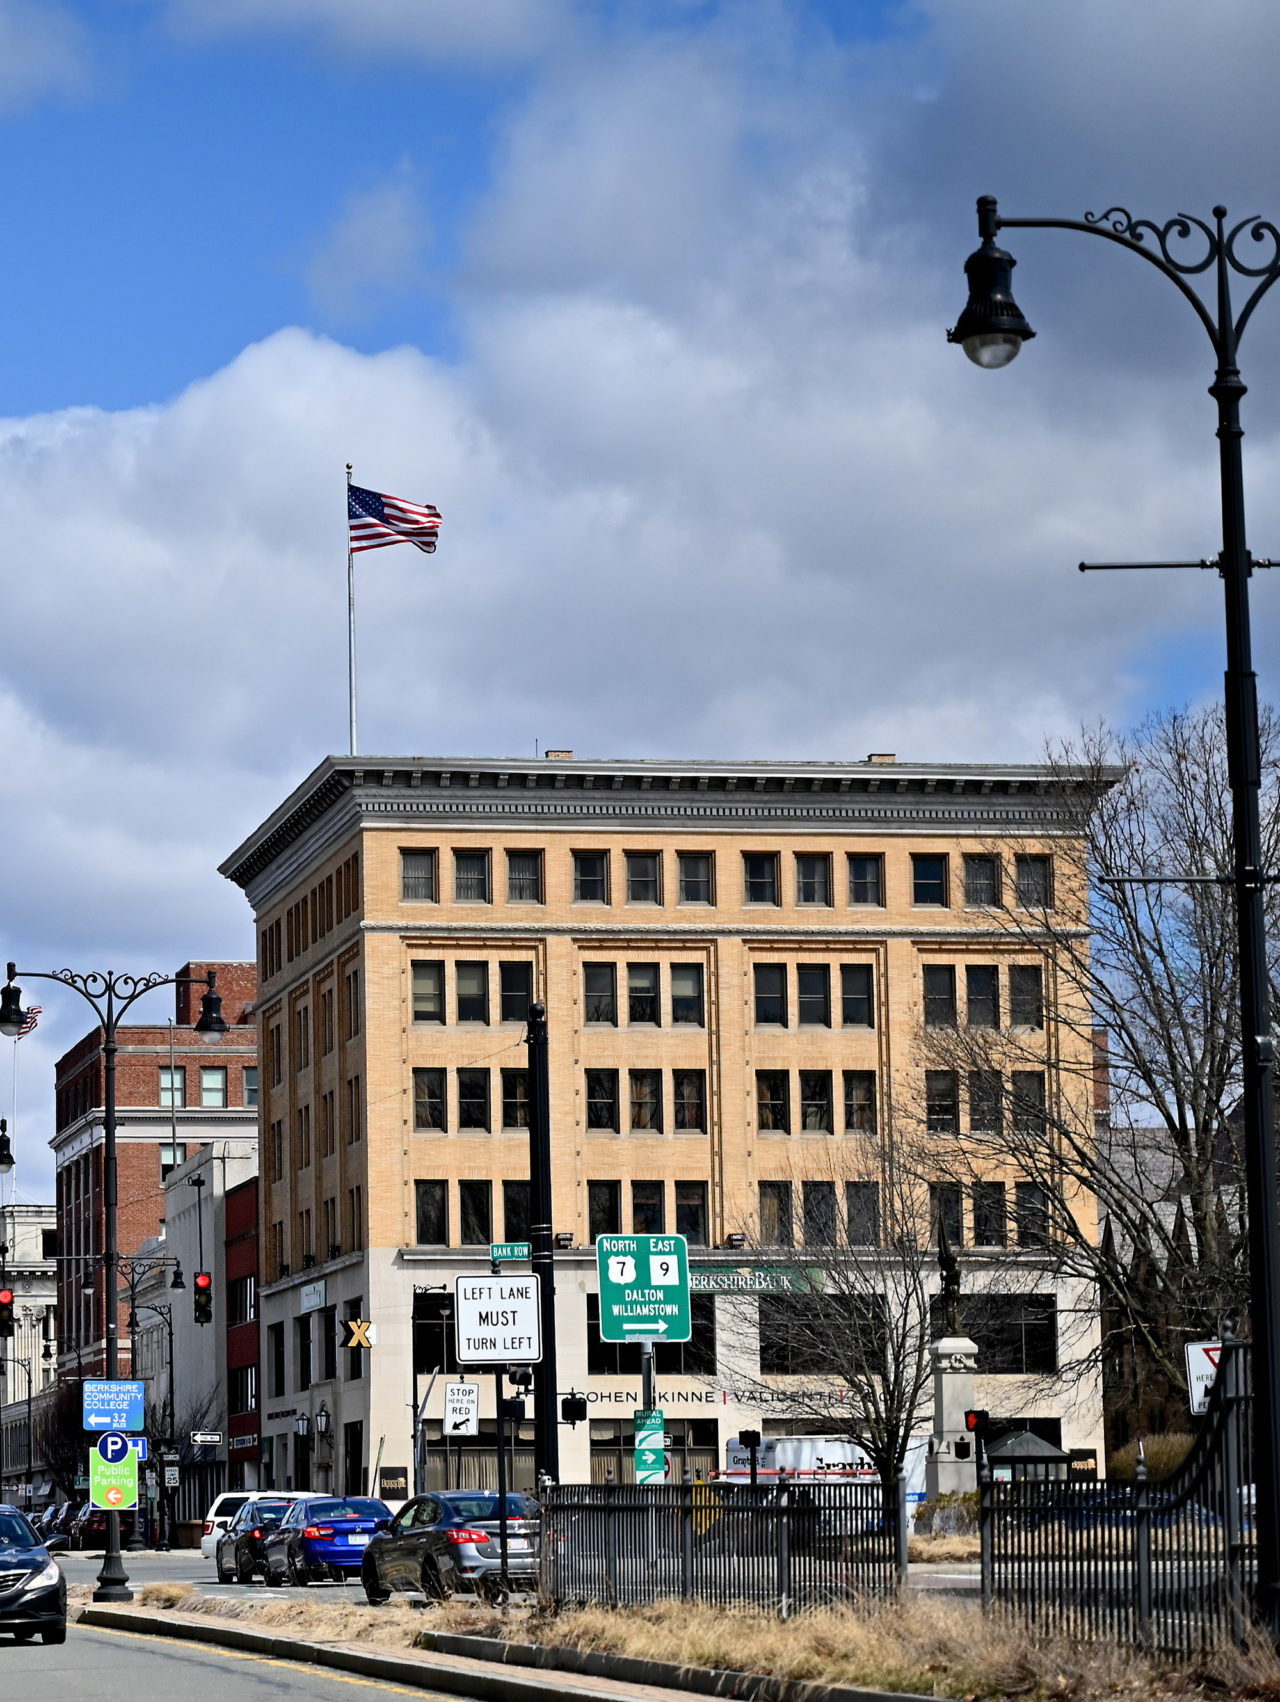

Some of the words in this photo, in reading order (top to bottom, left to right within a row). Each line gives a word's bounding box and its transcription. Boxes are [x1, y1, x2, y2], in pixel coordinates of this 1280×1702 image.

[603, 1238, 637, 1252] NORTH
[650, 1238, 676, 1252] EAST
[493, 1246, 512, 1257] BANK
[514, 1246, 528, 1256] ROW
[616, 1262, 626, 1276] 7
[660, 1262, 670, 1276] 9
[464, 1287, 492, 1300] LEFT
[500, 1286, 532, 1300] LANE
[625, 1289, 664, 1302] DALTON
[612, 1304, 678, 1316] WILLIAMSTOWN
[478, 1310, 518, 1326] MUST
[466, 1338, 496, 1350] TURN
[504, 1336, 532, 1350] LEFT
[1196, 1374, 1214, 1382] HERE
[84, 1384, 138, 1392] BERKSHIRE
[450, 1388, 474, 1397] STOP
[84, 1392, 142, 1401] COMMUNITY
[659, 1392, 715, 1403] KINNE
[84, 1401, 130, 1409] COLLEGE
[452, 1407, 470, 1415] RED
[113, 1413, 126, 1422] 3.2
[107, 1436, 122, 1459] P
[98, 1465, 130, 1475] Public
[94, 1476, 134, 1487] Parking
